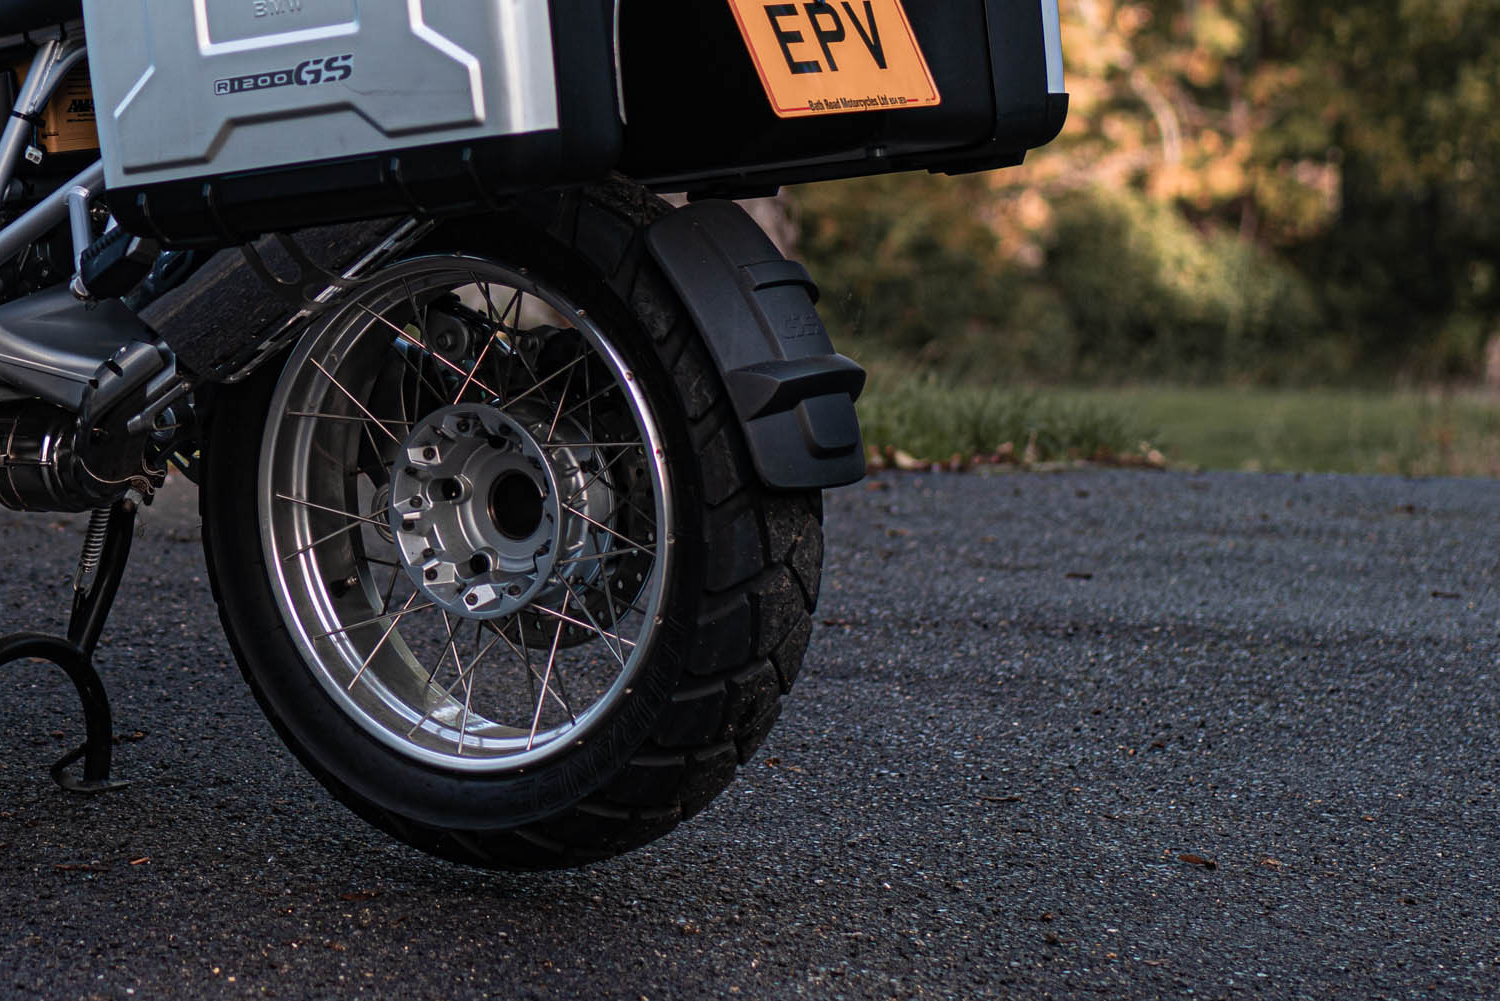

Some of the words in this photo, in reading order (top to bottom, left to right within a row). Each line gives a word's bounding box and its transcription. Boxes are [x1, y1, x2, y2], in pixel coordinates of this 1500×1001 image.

[764, 0, 888, 75] EPV
[808, 99, 825, 111] Bath
[824, 98, 841, 109] Road
[840, 95, 878, 111] Motorcycles
[877, 94, 888, 106] Ltd
